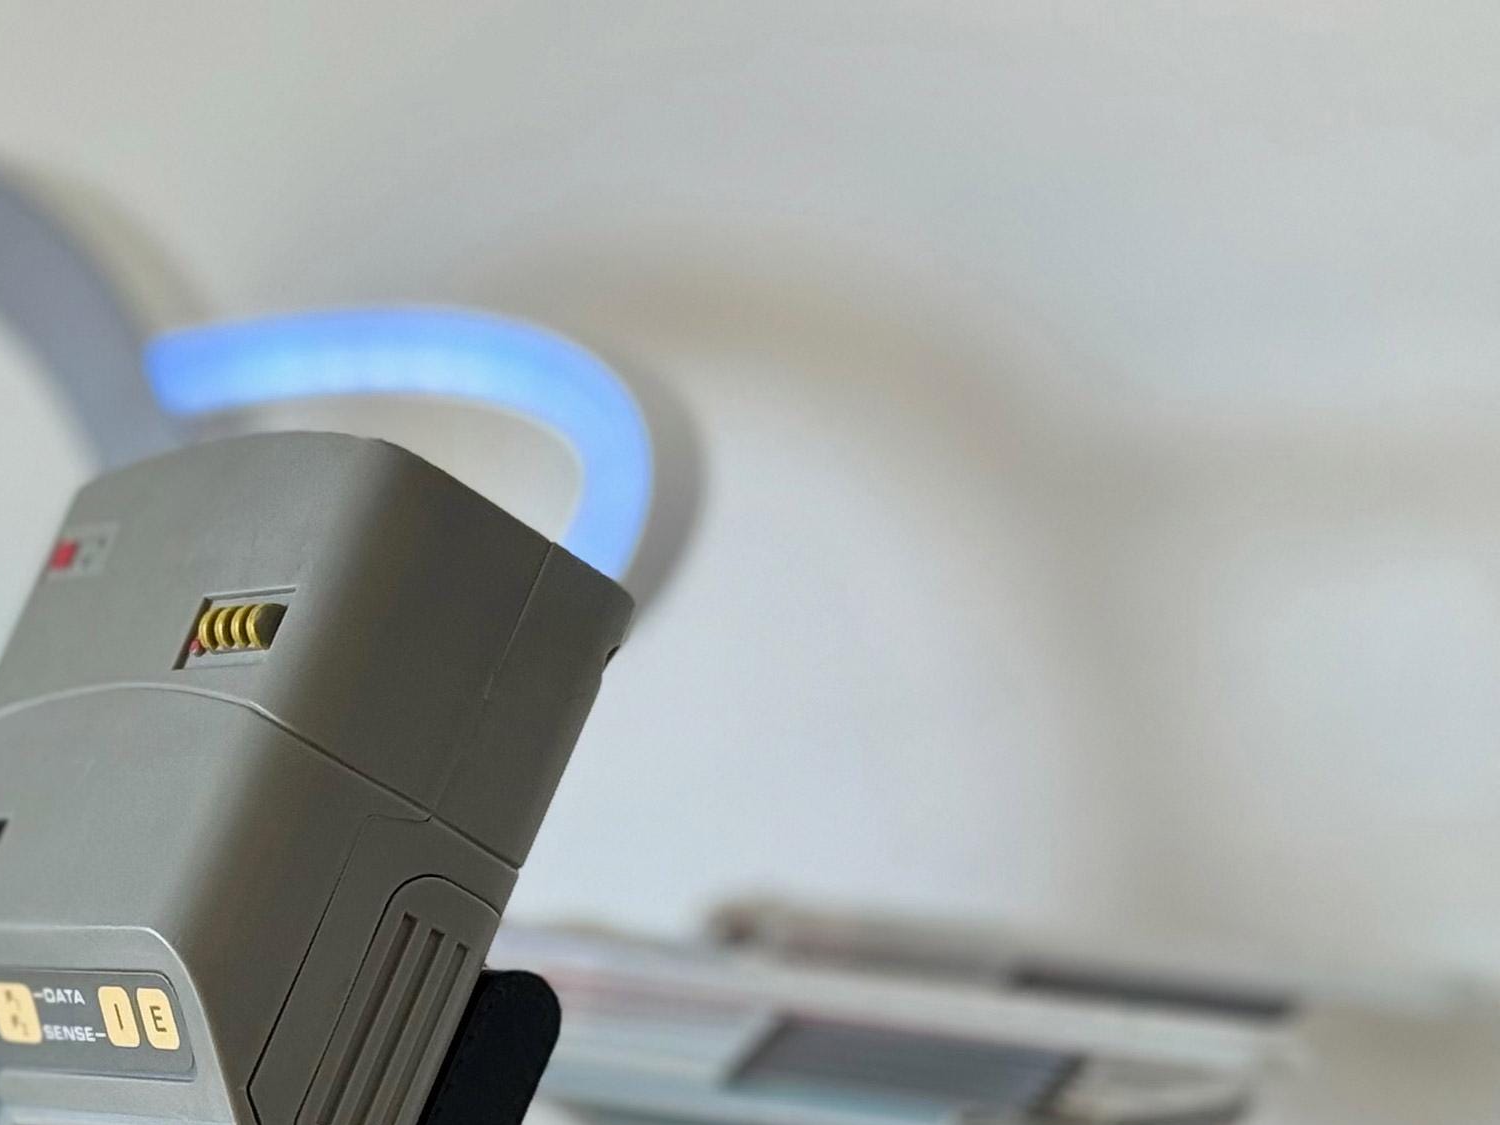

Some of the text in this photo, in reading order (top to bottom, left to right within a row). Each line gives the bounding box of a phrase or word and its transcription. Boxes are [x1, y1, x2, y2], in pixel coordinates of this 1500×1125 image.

[43, 988, 86, 1005] DATA
[150, 1006, 167, 1032] E
[43, 1026, 97, 1042] SENSE
